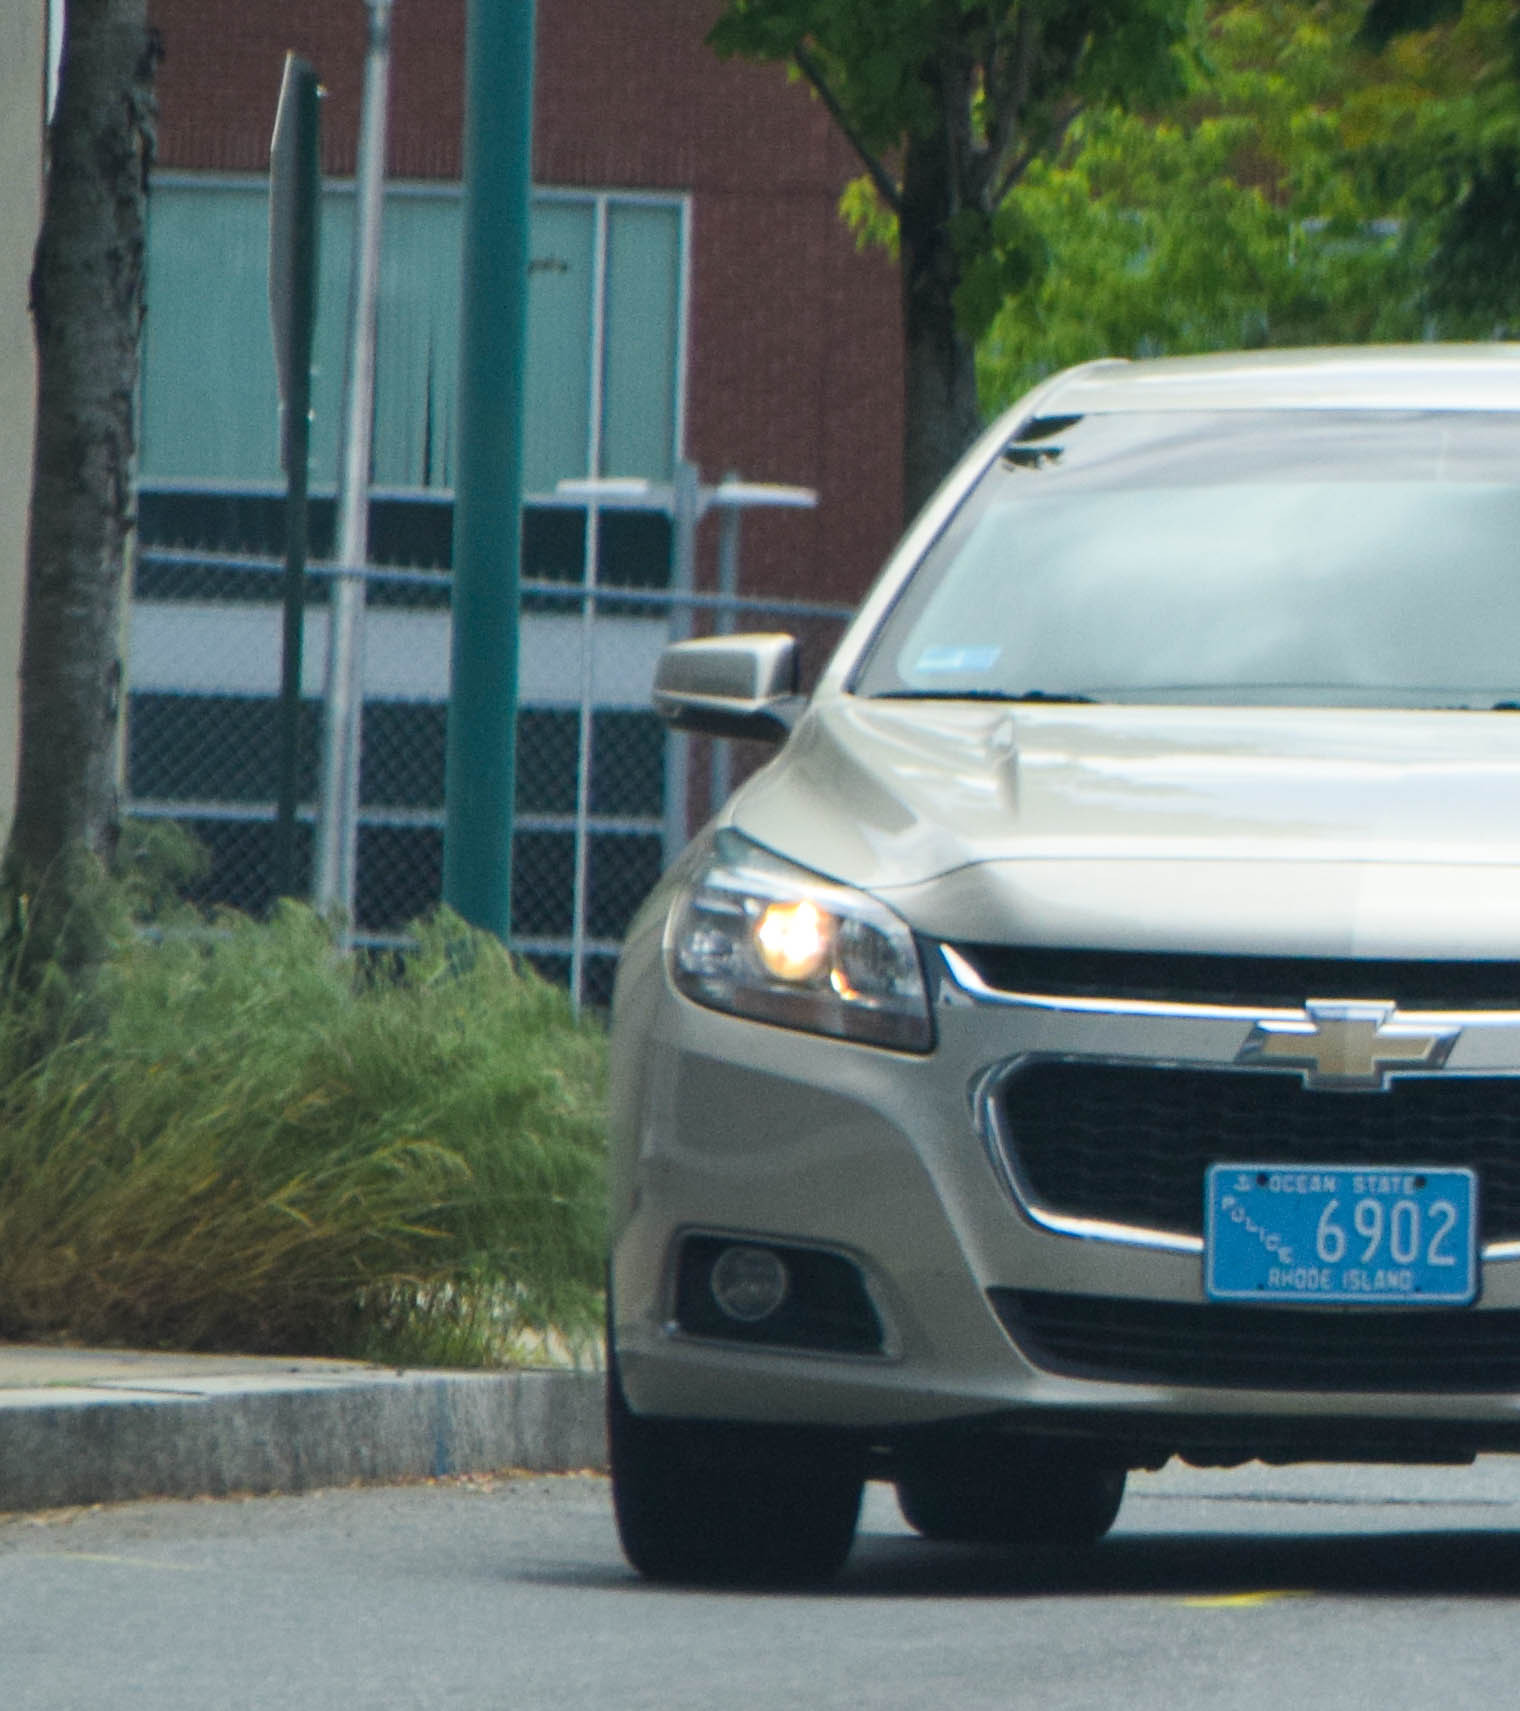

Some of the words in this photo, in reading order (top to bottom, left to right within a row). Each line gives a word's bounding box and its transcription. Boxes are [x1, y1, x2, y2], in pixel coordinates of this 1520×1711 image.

[1269, 1174, 1337, 1194] OCEAN
[1354, 1175, 1417, 1195] STATE
[1222, 1196, 1294, 1264] POLICE
[1316, 1198, 1456, 1267] 6902
[1268, 1268, 1334, 1289] RHODE
[1343, 1269, 1414, 1291] ISLAND
